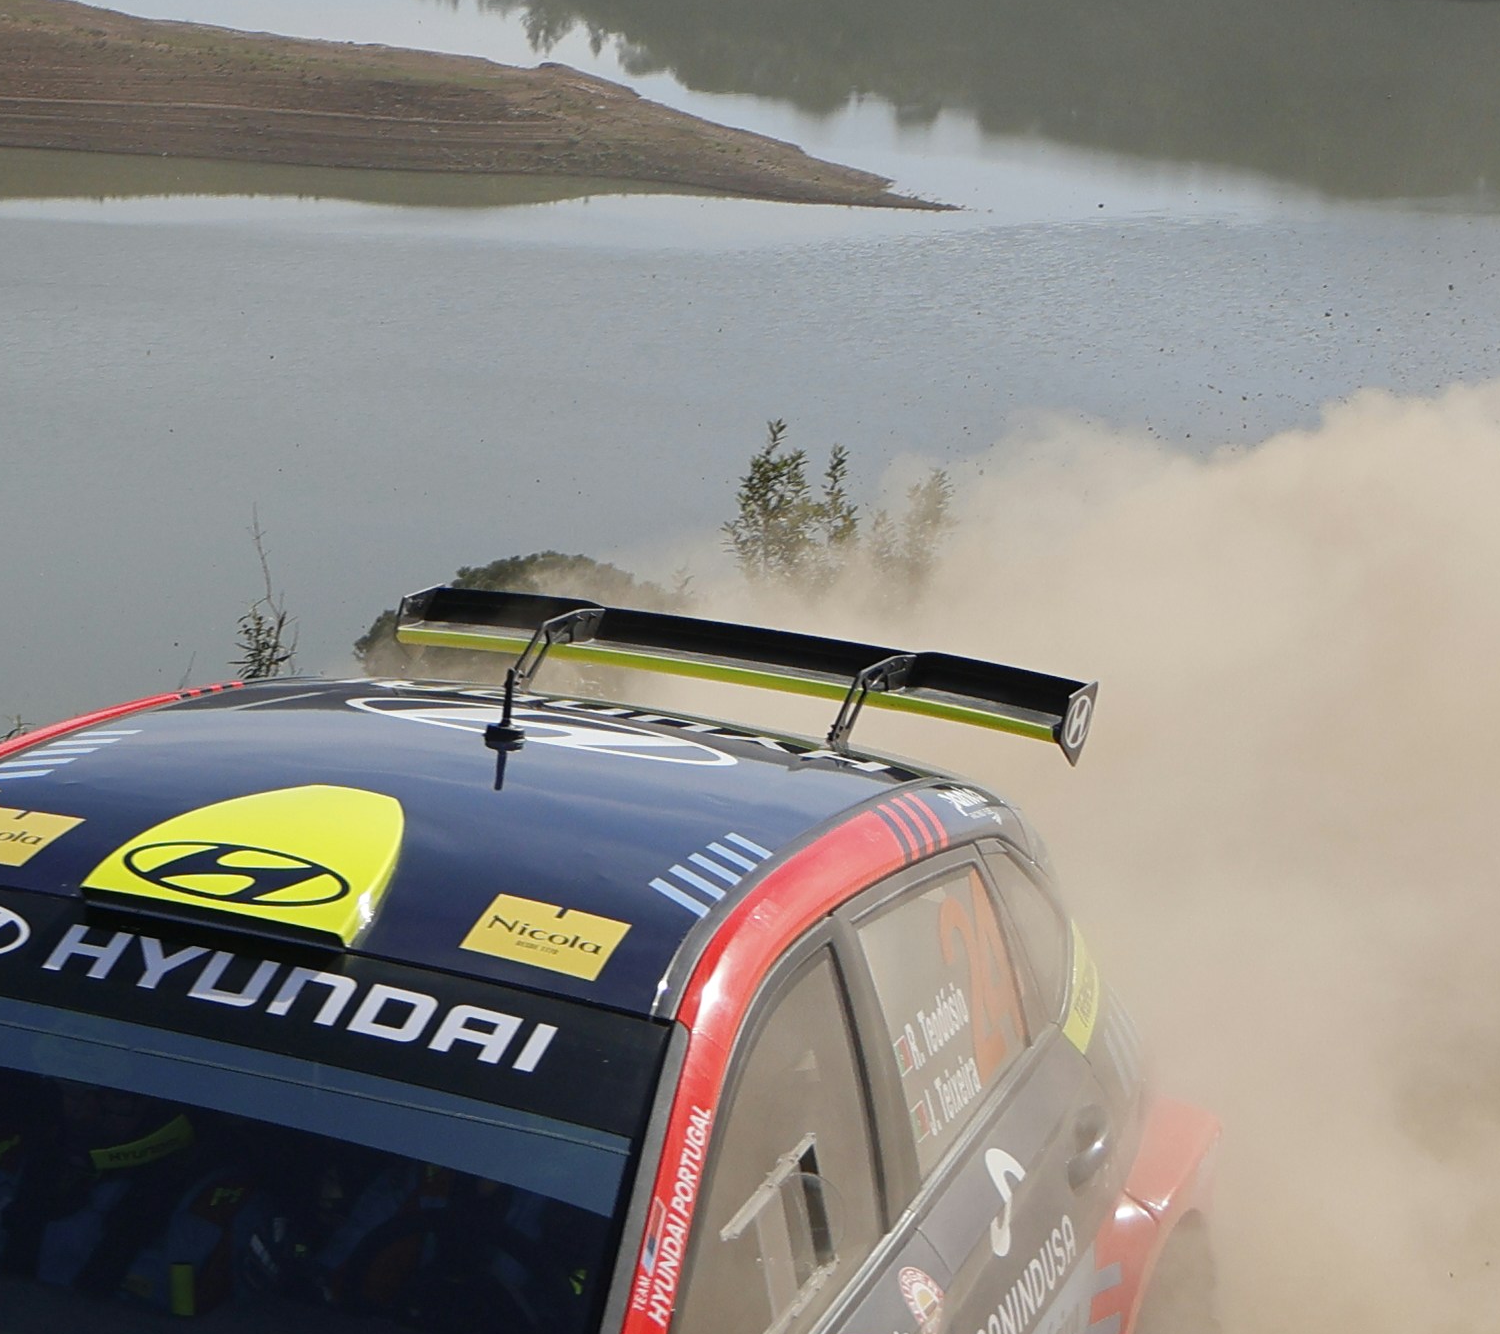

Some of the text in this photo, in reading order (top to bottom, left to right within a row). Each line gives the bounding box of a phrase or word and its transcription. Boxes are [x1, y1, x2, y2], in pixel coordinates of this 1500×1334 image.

[487, 915, 603, 955] Nicola
[42, 923, 558, 1072] HYUNDAI
[904, 1023, 926, 1070] R.
[934, 1055, 982, 1122] Teixeira
[647, 1105, 712, 1327] HYUNDAI PORTUGAL
[632, 1275, 651, 1310] TEAM
